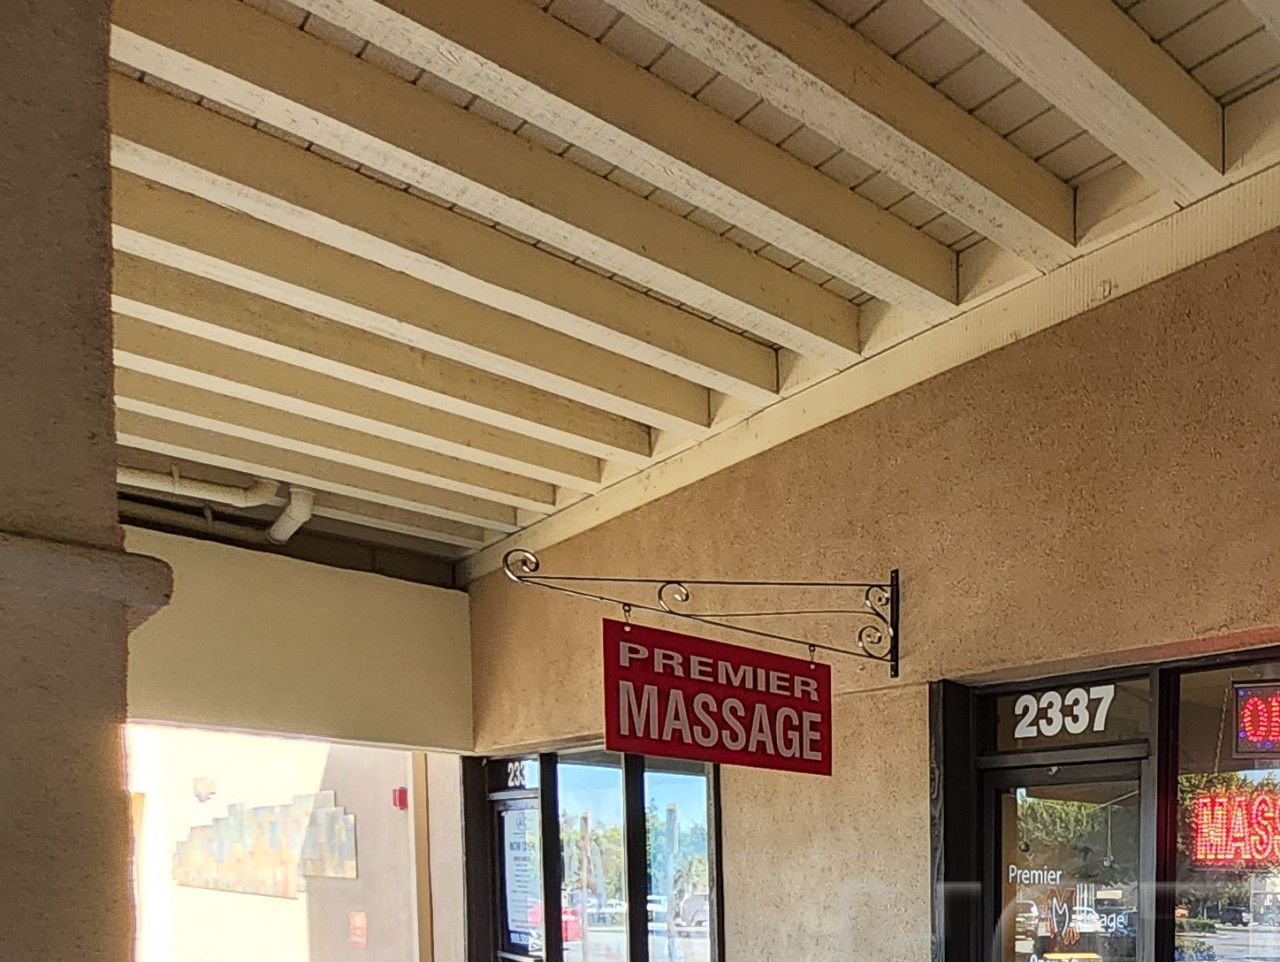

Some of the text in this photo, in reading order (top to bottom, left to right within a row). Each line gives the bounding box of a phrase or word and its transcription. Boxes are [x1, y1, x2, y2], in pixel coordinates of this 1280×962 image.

[619, 641, 819, 701] PREMIER
[619, 680, 822, 761] MASSAGE
[1014, 684, 1115, 738] 2337
[1008, 865, 1062, 885] Premier
